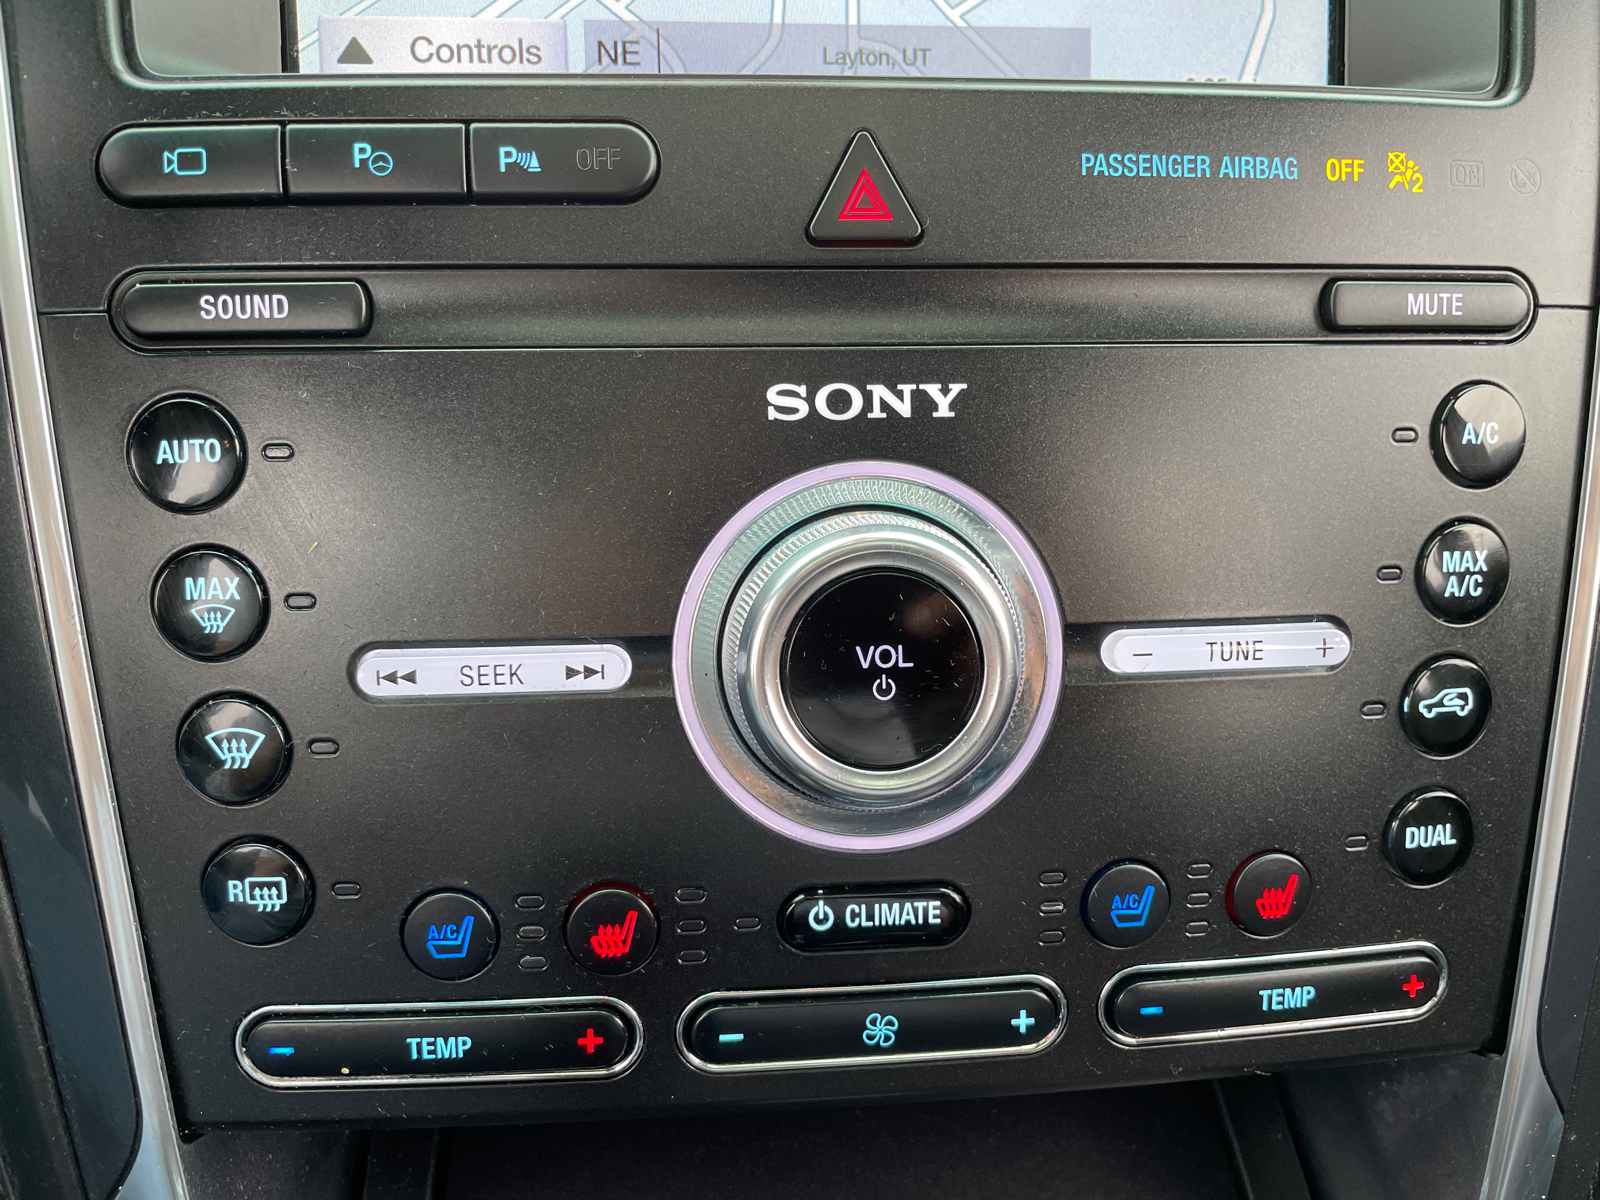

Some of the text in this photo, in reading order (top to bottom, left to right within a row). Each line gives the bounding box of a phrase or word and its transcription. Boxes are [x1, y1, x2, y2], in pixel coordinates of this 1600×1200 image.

[409, 36, 543, 66] Controls
[596, 40, 642, 67] NE
[822, 46, 932, 69] Layton, UT
[576, 147, 621, 171] OFF
[1081, 153, 1365, 182] PASSENGER AIRBAG OFF
[1454, 163, 1481, 184] ON
[199, 295, 290, 320] SOUND
[1406, 293, 1464, 316] MUTE
[765, 383, 968, 421] SONY
[1461, 422, 1500, 446] A/C
[156, 438, 222, 465] AUTO
[1442, 550, 1489, 574] MAX
[184, 576, 241, 602] MAX
[1444, 575, 1484, 598] A/C
[855, 644, 915, 670] VOL
[1205, 639, 1264, 663] TUNE
[459, 664, 525, 687] SEEK
[1404, 824, 1456, 849] DUAL
[1110, 893, 1141, 910] A/C
[845, 900, 942, 929] CLIMATE
[426, 924, 459, 940] A/C
[1258, 985, 1317, 1012] TEMP
[406, 1036, 473, 1061] TEMP
